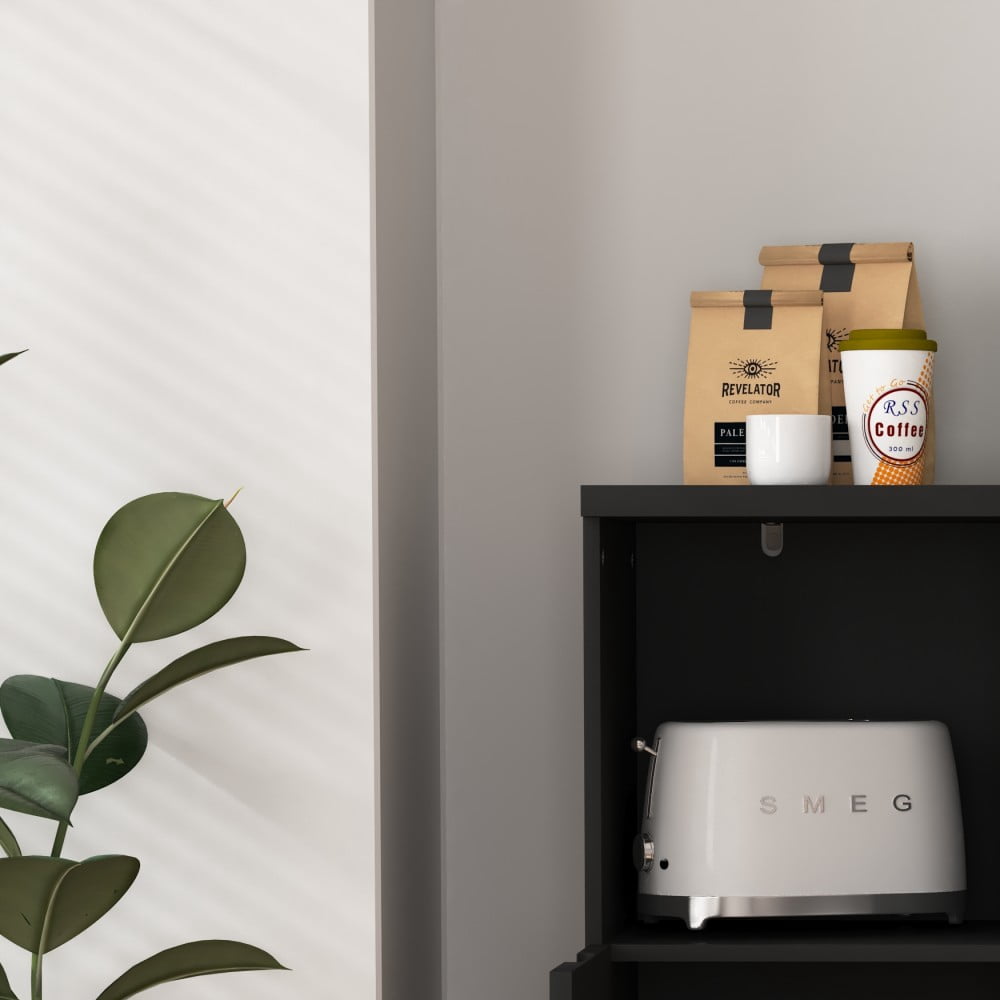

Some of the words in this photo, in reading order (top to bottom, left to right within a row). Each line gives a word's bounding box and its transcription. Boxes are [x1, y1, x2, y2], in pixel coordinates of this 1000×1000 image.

[721, 382, 780, 398] REVELATOR
[883, 399, 920, 417] RSS
[720, 428, 745, 437] PALE
[875, 422, 924, 438] Coffee
[759, 794, 912, 814] SMEG
